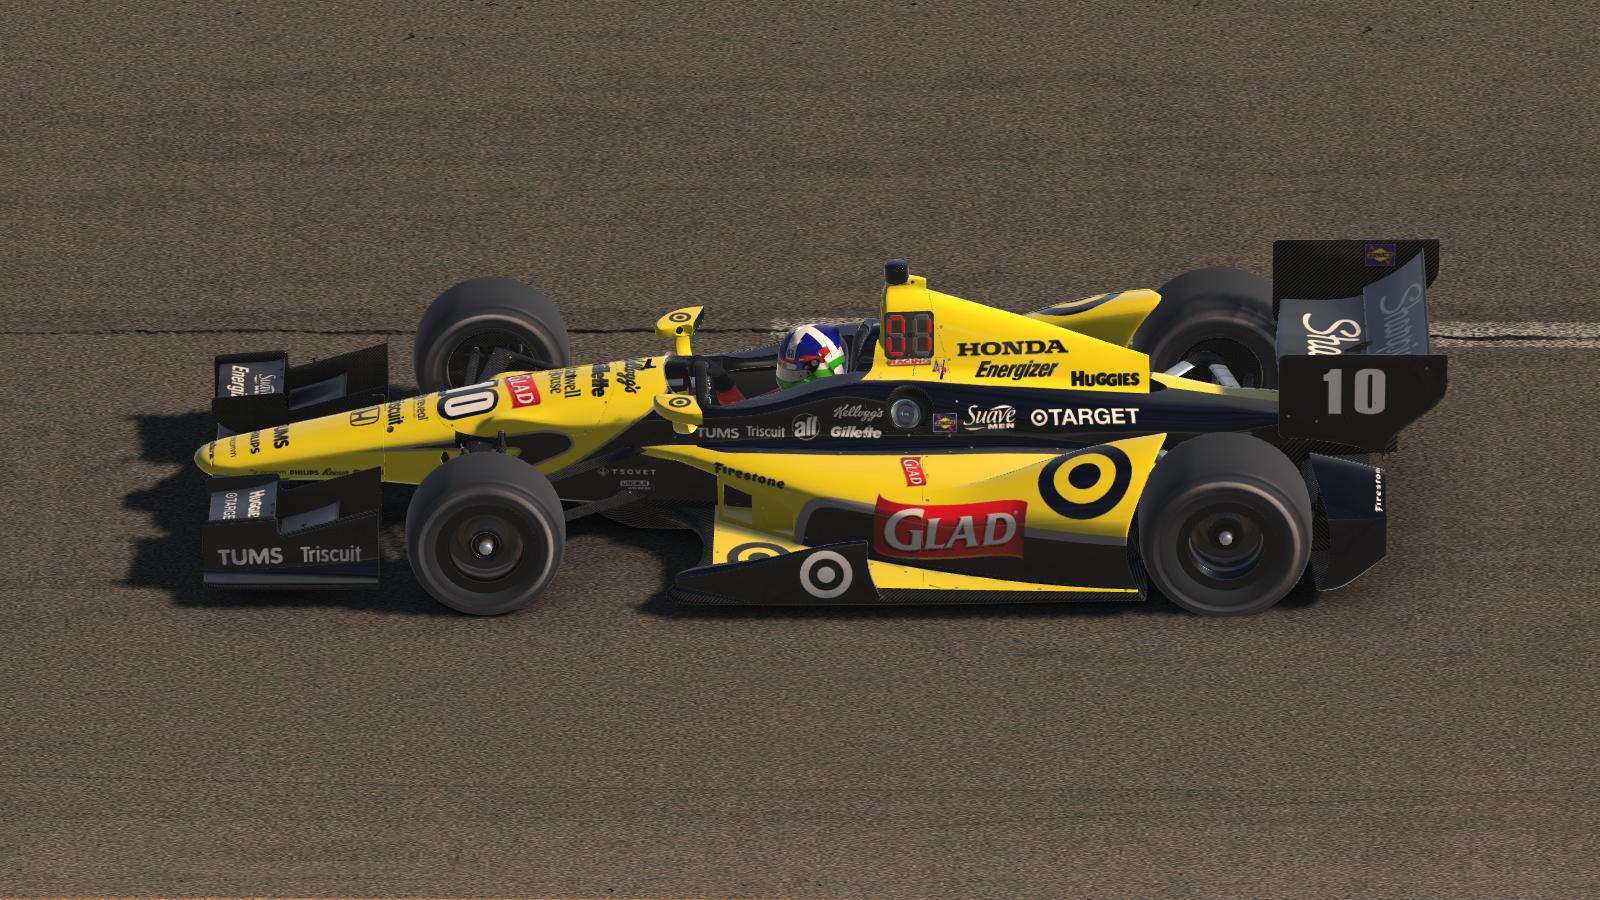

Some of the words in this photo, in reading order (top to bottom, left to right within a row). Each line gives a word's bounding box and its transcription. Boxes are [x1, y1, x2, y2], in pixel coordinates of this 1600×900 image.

[1376, 283, 1422, 355] Sharpi
[956, 339, 1069, 357] HONDA
[226, 365, 250, 397] Energi
[974, 360, 1059, 381] Energizer
[1071, 370, 1140, 387] HUGGIES
[508, 373, 535, 405] GLAD
[1322, 368, 1387, 415] 10
[832, 404, 884, 422] Kellogg's
[963, 404, 1016, 426] Suave
[1048, 408, 1139, 426] TARGET
[698, 427, 740, 439] TUMS
[746, 425, 785, 439] Triscuit
[793, 415, 818, 438] all
[830, 425, 883, 439] Gillette
[713, 461, 786, 490] Firestone
[903, 459, 923, 485] GLAD
[1374, 467, 1384, 513] Fireston
[222, 497, 237, 520] TARGE
[247, 489, 265, 518] HUGGIE
[883, 508, 1017, 551] GLAD
[217, 547, 284, 567] TUMS
[300, 545, 362, 564] Triscuit
